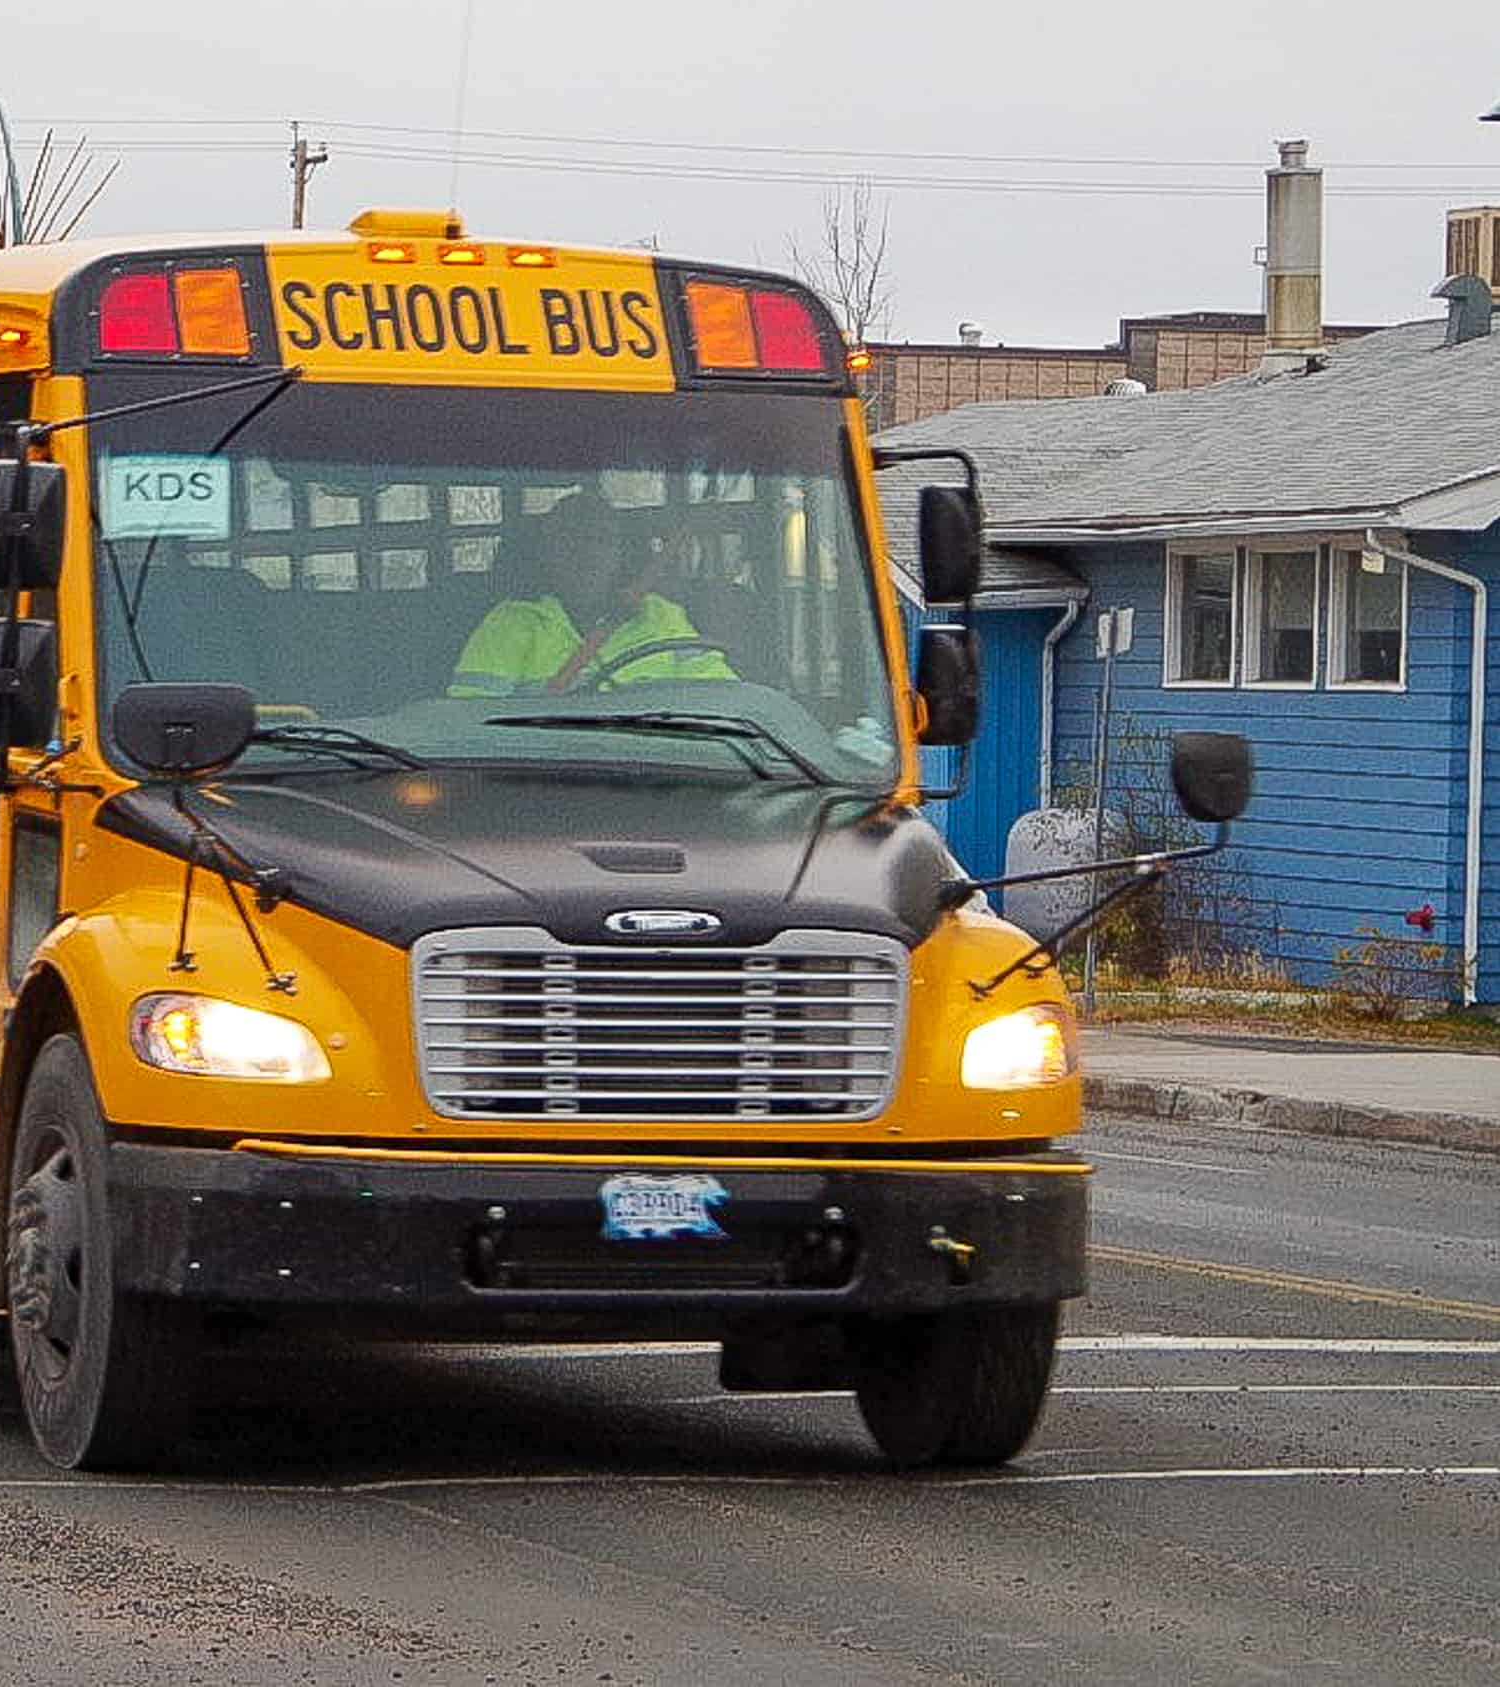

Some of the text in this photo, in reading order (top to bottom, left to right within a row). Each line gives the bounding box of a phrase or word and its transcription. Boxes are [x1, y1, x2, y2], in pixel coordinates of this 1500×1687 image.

[282, 281, 658, 359] SCHOOL BUS
[125, 471, 213, 501] KDS
